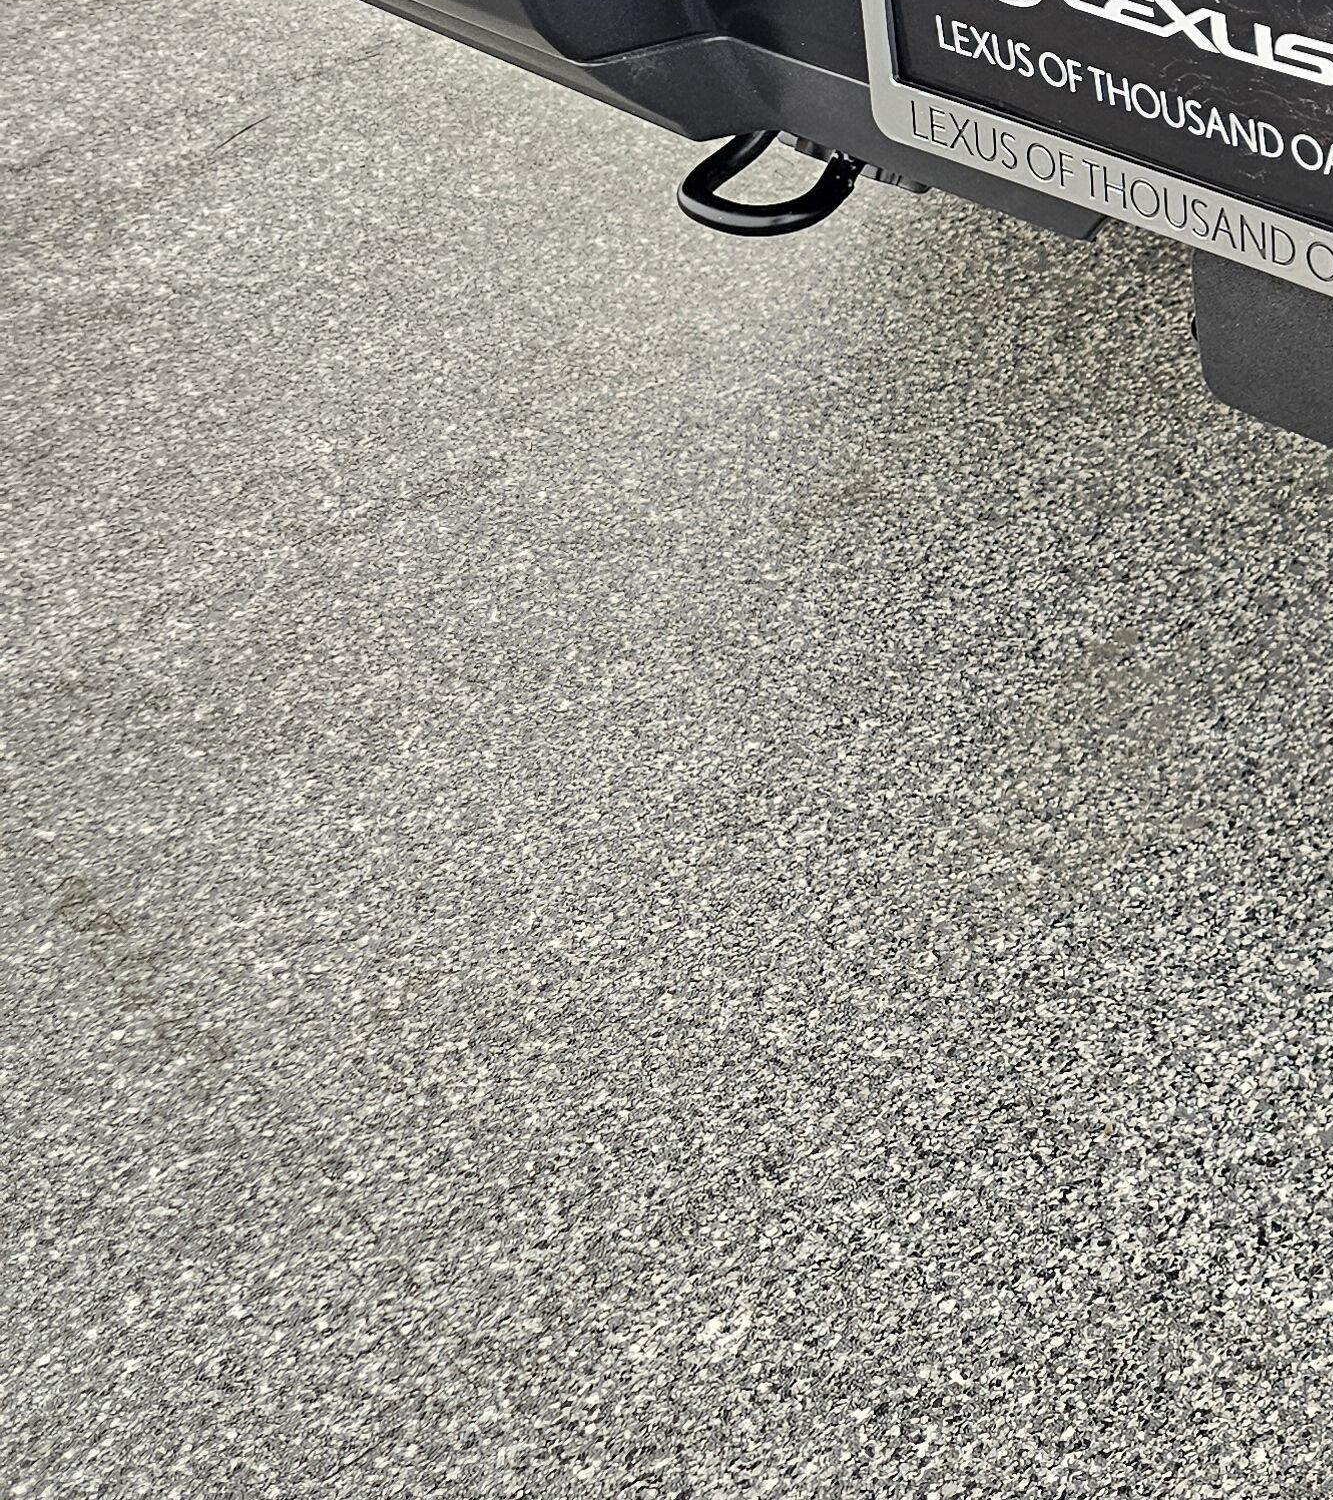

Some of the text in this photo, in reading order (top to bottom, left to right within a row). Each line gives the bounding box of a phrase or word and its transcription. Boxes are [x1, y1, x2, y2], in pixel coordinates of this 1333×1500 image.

[935, 14, 1035, 78] LEXUS
[1038, 51, 1083, 93] OF
[1087, 65, 1285, 159] THOUSAND
[910, 99, 1018, 170] LEXUS
[1026, 142, 1075, 188] OF
[1082, 157, 1296, 267] THOUSAND
